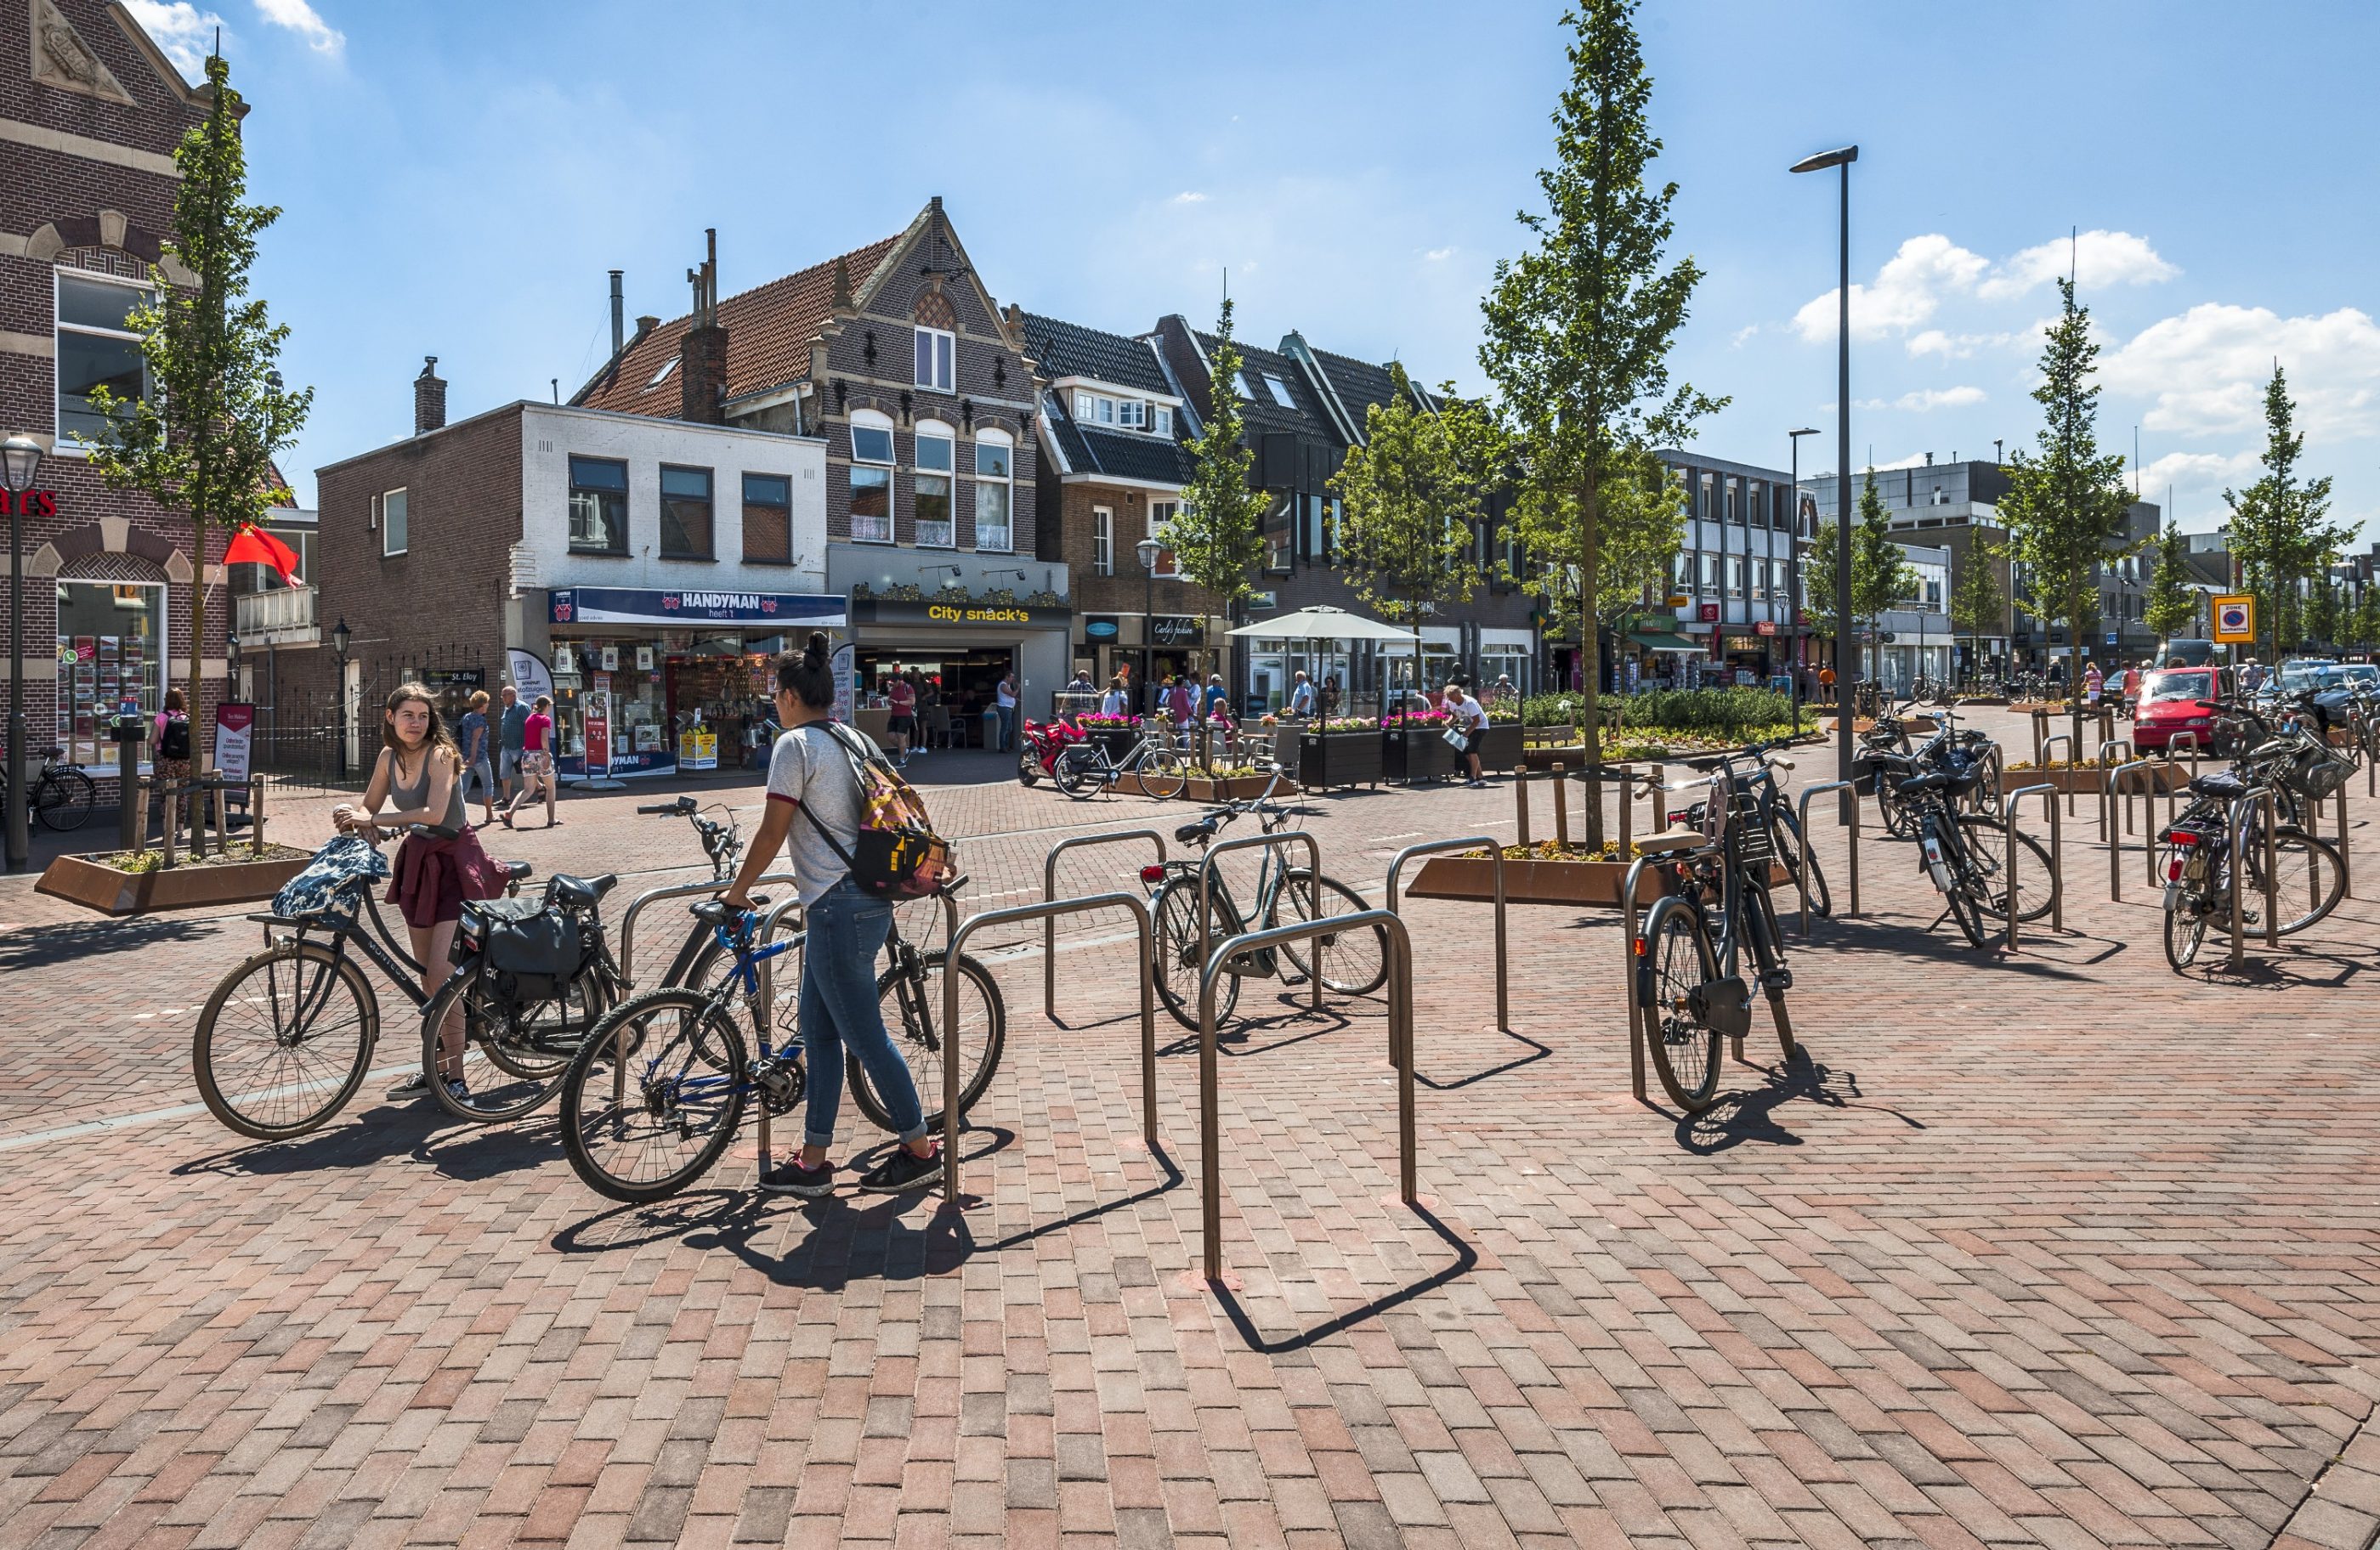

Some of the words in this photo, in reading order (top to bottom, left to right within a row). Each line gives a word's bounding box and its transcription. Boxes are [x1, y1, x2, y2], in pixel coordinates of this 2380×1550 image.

[683, 593, 759, 609] HANDYMAN
[709, 609, 728, 618] heeft
[729, 609, 734, 618] 't
[928, 606, 962, 623] City
[966, 608, 1029, 622] snack's
[451, 672, 461, 681] St.
[462, 672, 478, 682] Eloy
[611, 755, 639, 766] DYMAN
[368, 940, 407, 981] MONTEGO
